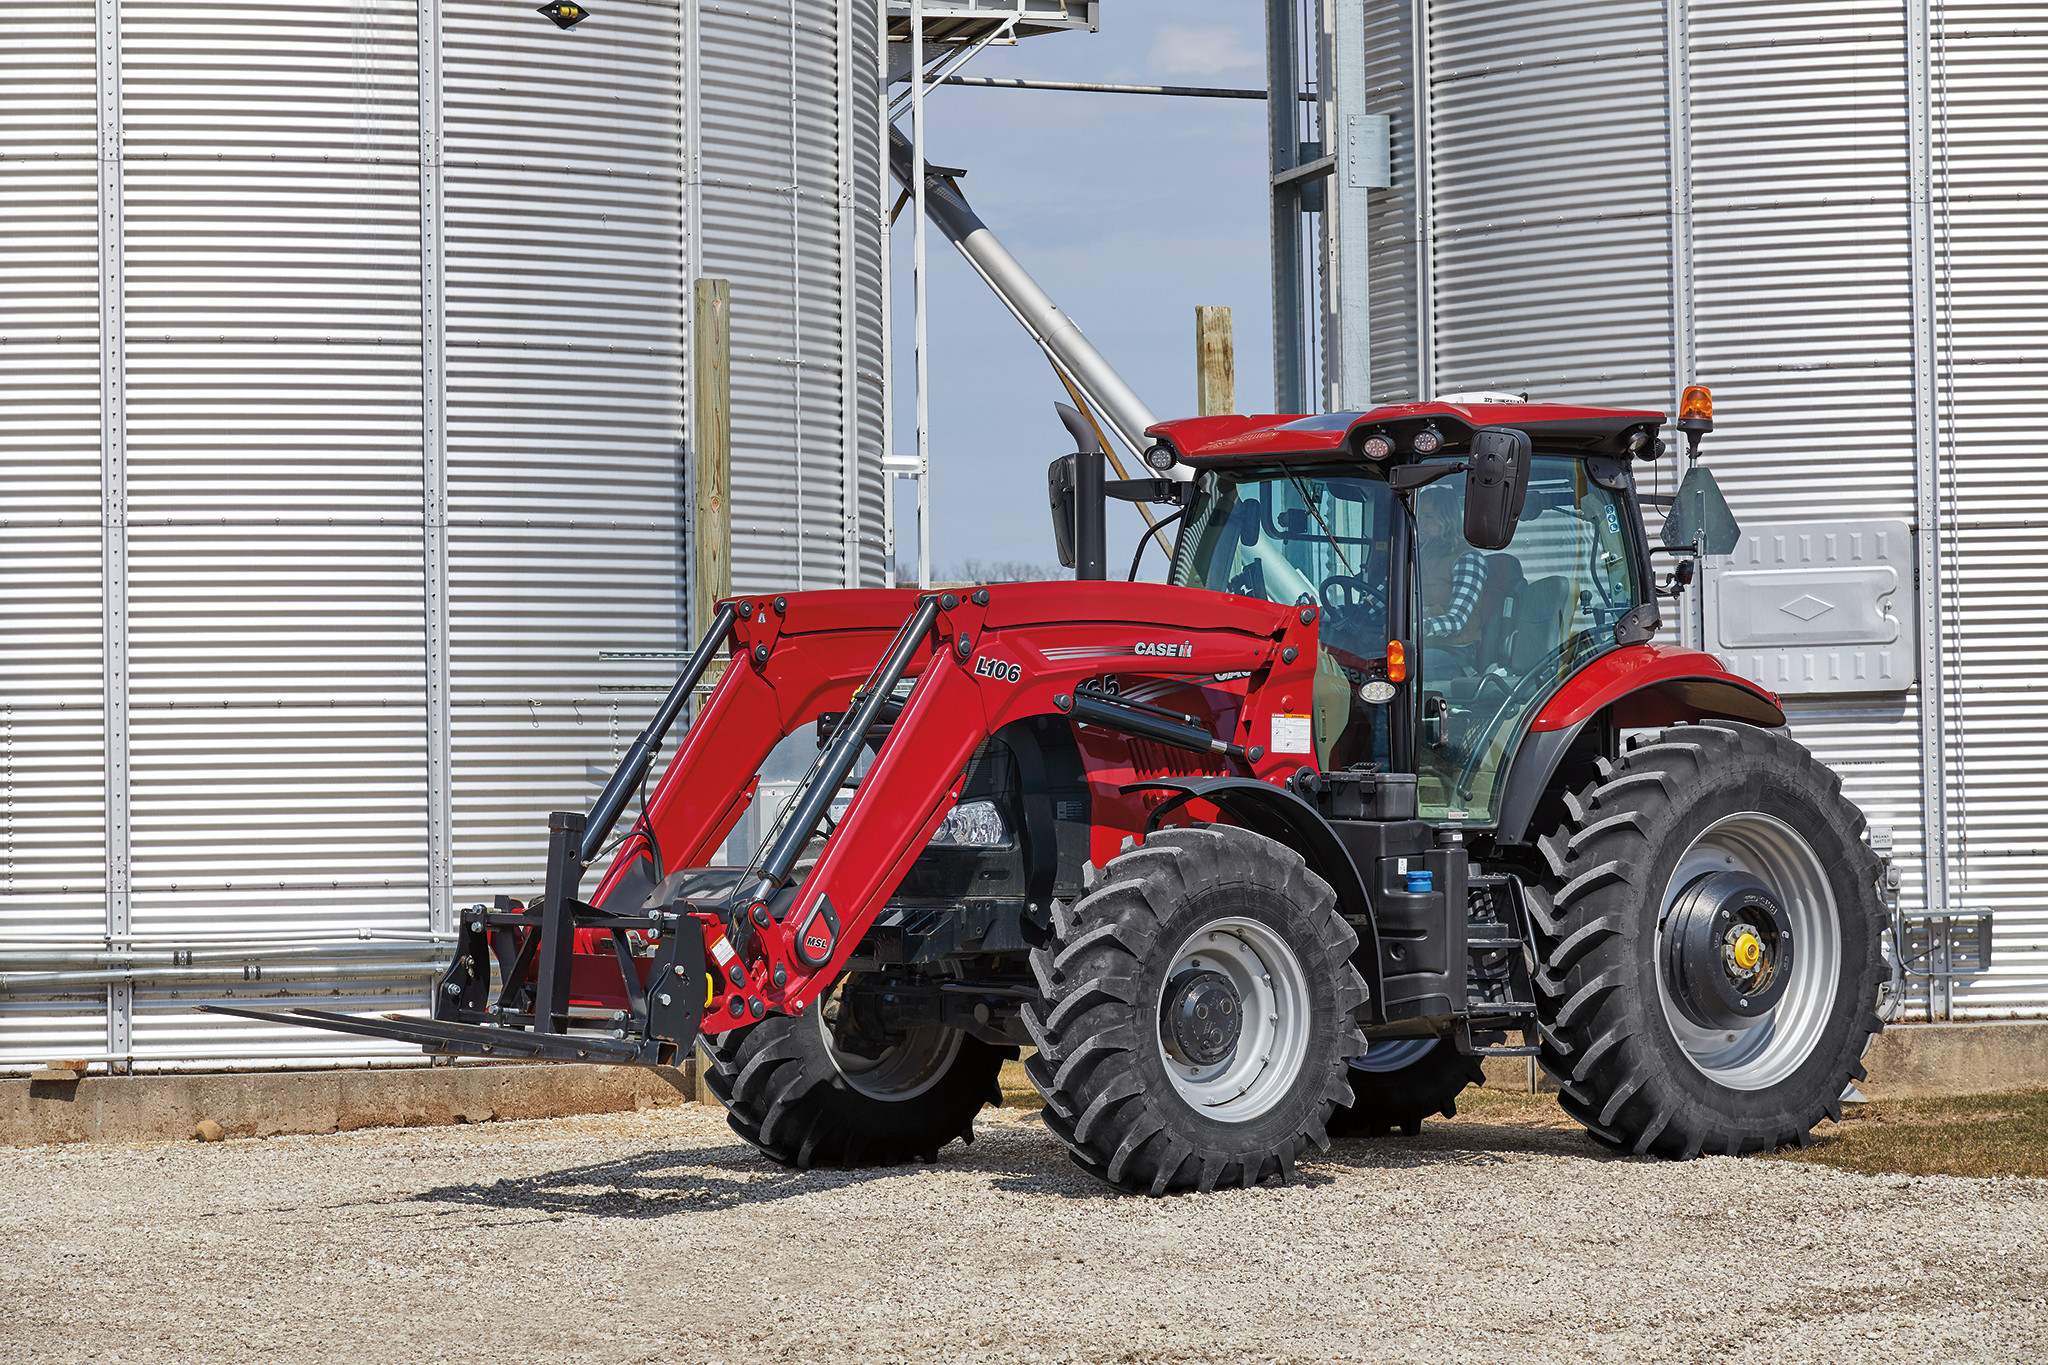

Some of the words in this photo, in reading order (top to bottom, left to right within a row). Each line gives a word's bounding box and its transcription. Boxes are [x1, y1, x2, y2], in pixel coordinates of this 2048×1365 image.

[1134, 642, 1177, 657] CASE
[974, 655, 1022, 684] L106
[806, 935, 827, 948] MSL
